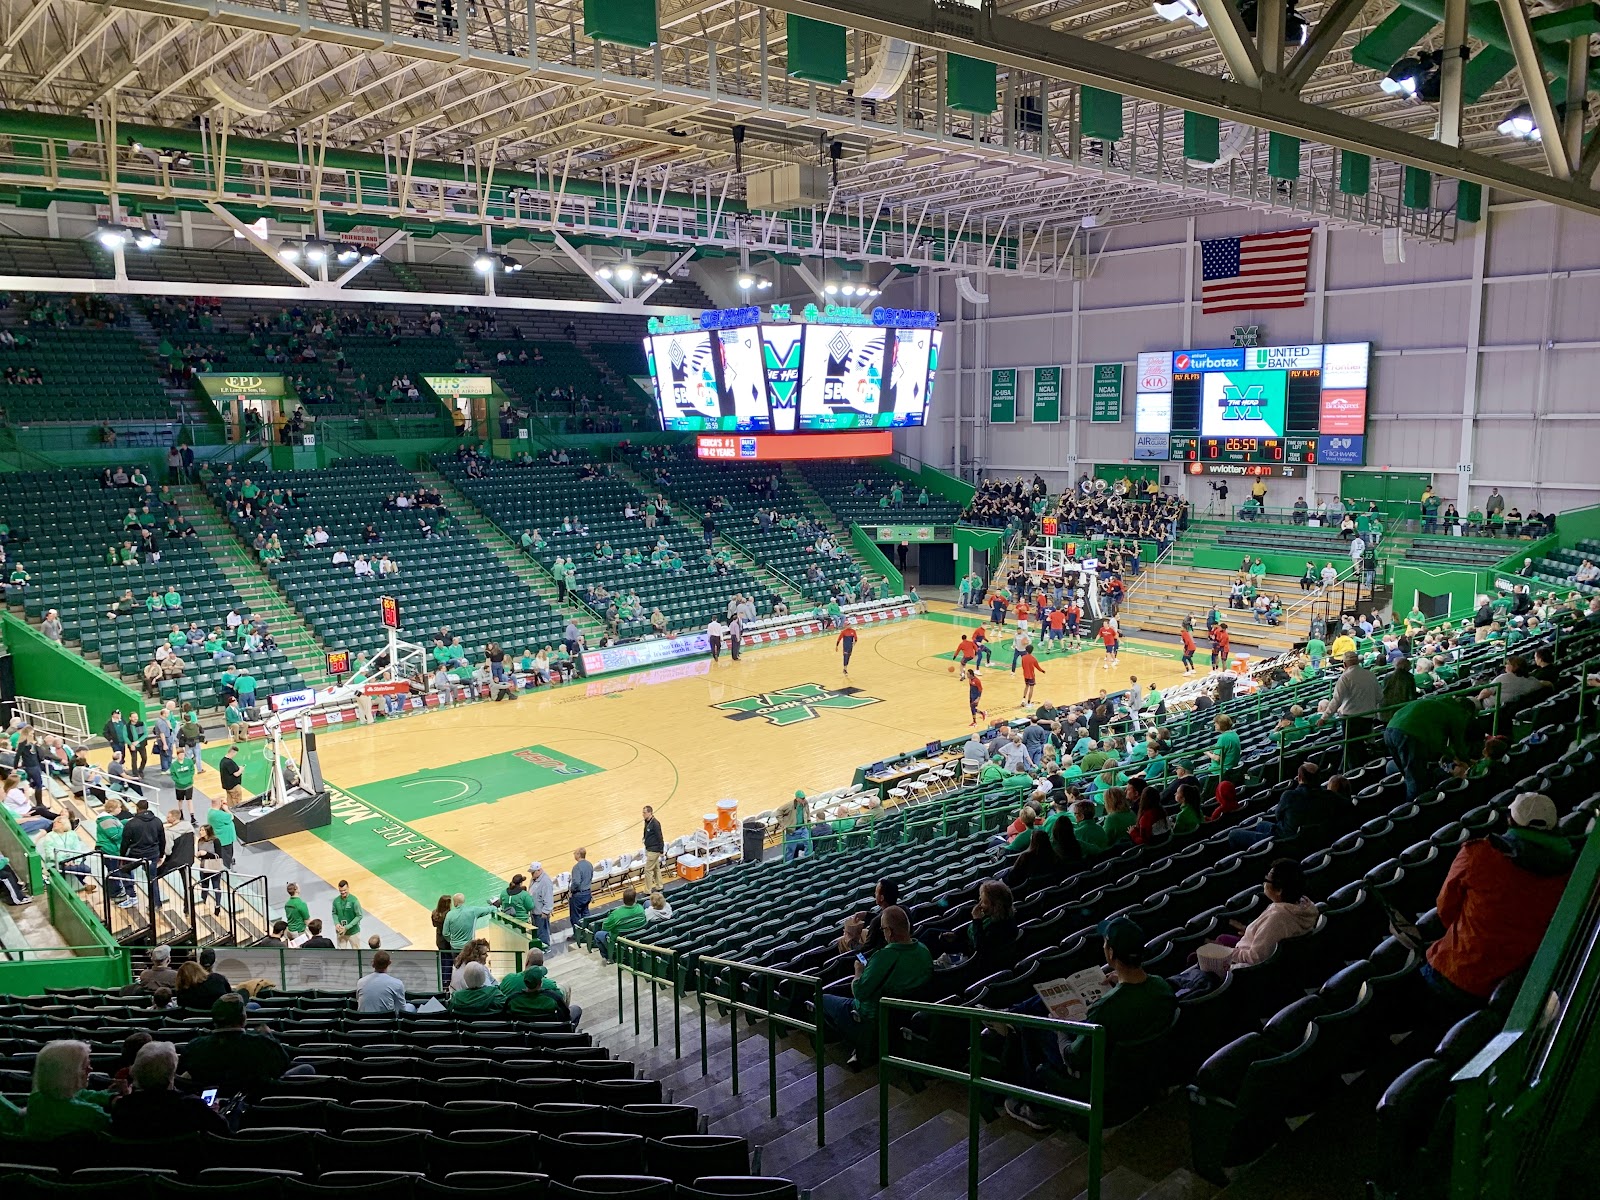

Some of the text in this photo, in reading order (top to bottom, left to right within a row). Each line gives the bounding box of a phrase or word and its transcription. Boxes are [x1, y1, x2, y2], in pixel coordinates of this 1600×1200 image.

[1268, 346, 1310, 358] UNITED
[1191, 356, 1239, 369] turbotax
[1268, 357, 1298, 368] BANK
[1146, 378, 1164, 387] KIA
[1222, 385, 1264, 420] M
[1138, 436, 1150, 446] AIR
[1190, 439, 1196, 448] 4
[1227, 438, 1256, 450] 26:59
[1309, 441, 1315, 450] 4
[716, 448, 736, 457] YEARS
[1190, 450, 1196, 460] 0
[1211, 446, 1218, 458] 0
[1275, 447, 1282, 459] 0
[1308, 452, 1314, 463] 0
[1322, 450, 1359, 458] HIGHMARK
[1209, 465, 1272, 476] wvlottery.com
[1045, 523, 1055, 534] 30
[329, 653, 347, 662] 26:59
[333, 662, 344, 671] 30
[756, 693, 839, 714] THE HERD
[681, 865, 687, 876] G
